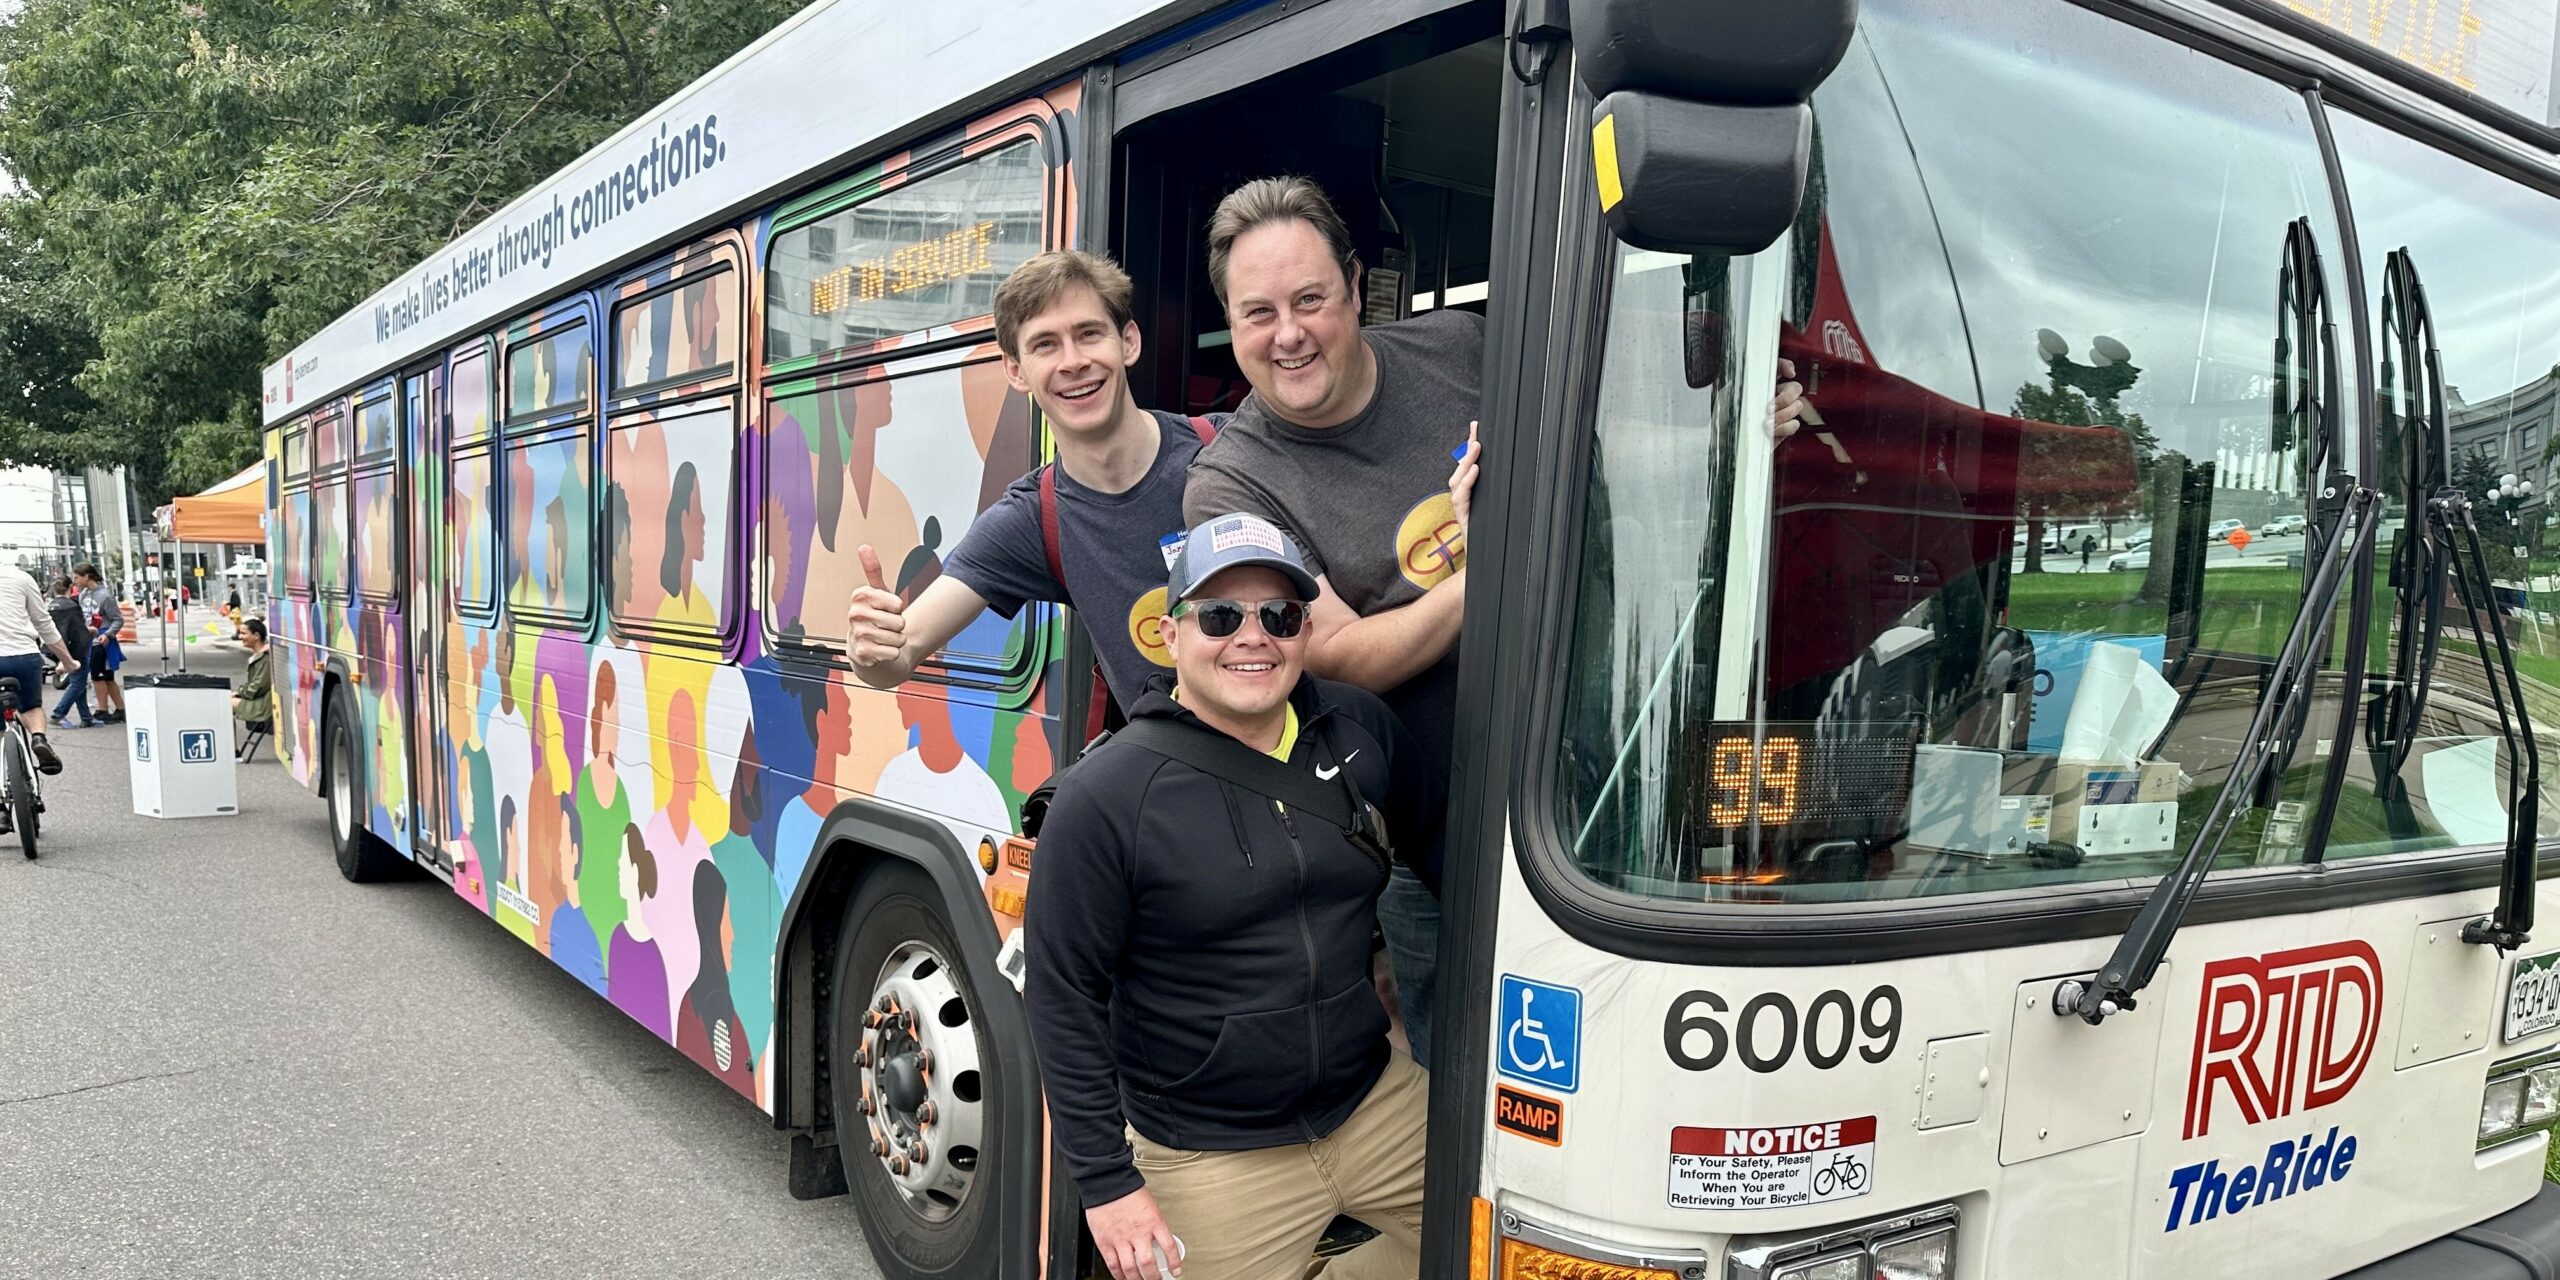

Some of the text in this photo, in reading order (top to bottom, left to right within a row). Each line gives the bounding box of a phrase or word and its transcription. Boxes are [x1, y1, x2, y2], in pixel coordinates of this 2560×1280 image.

[375, 114, 726, 344] We make lives better through connections.
[859, 255, 885, 303] IN
[1711, 737, 1799, 824] 99
[1663, 985, 1903, 1074] 6009
[2182, 939, 2384, 1141] RTD
[2523, 1013, 2555, 1032] COLORADO
[1500, 1096, 1557, 1131] RAMP
[1725, 1122, 1842, 1155] NOTICE
[1672, 1154, 1811, 1169] For Your Safety, Please
[1680, 1168, 1800, 1182] Inform the Operator
[2164, 1125, 2358, 1233] TheRide
[1671, 1191, 1807, 1207] Retrieving Your Bicycle
[1702, 1182, 1785, 1193] When You are
